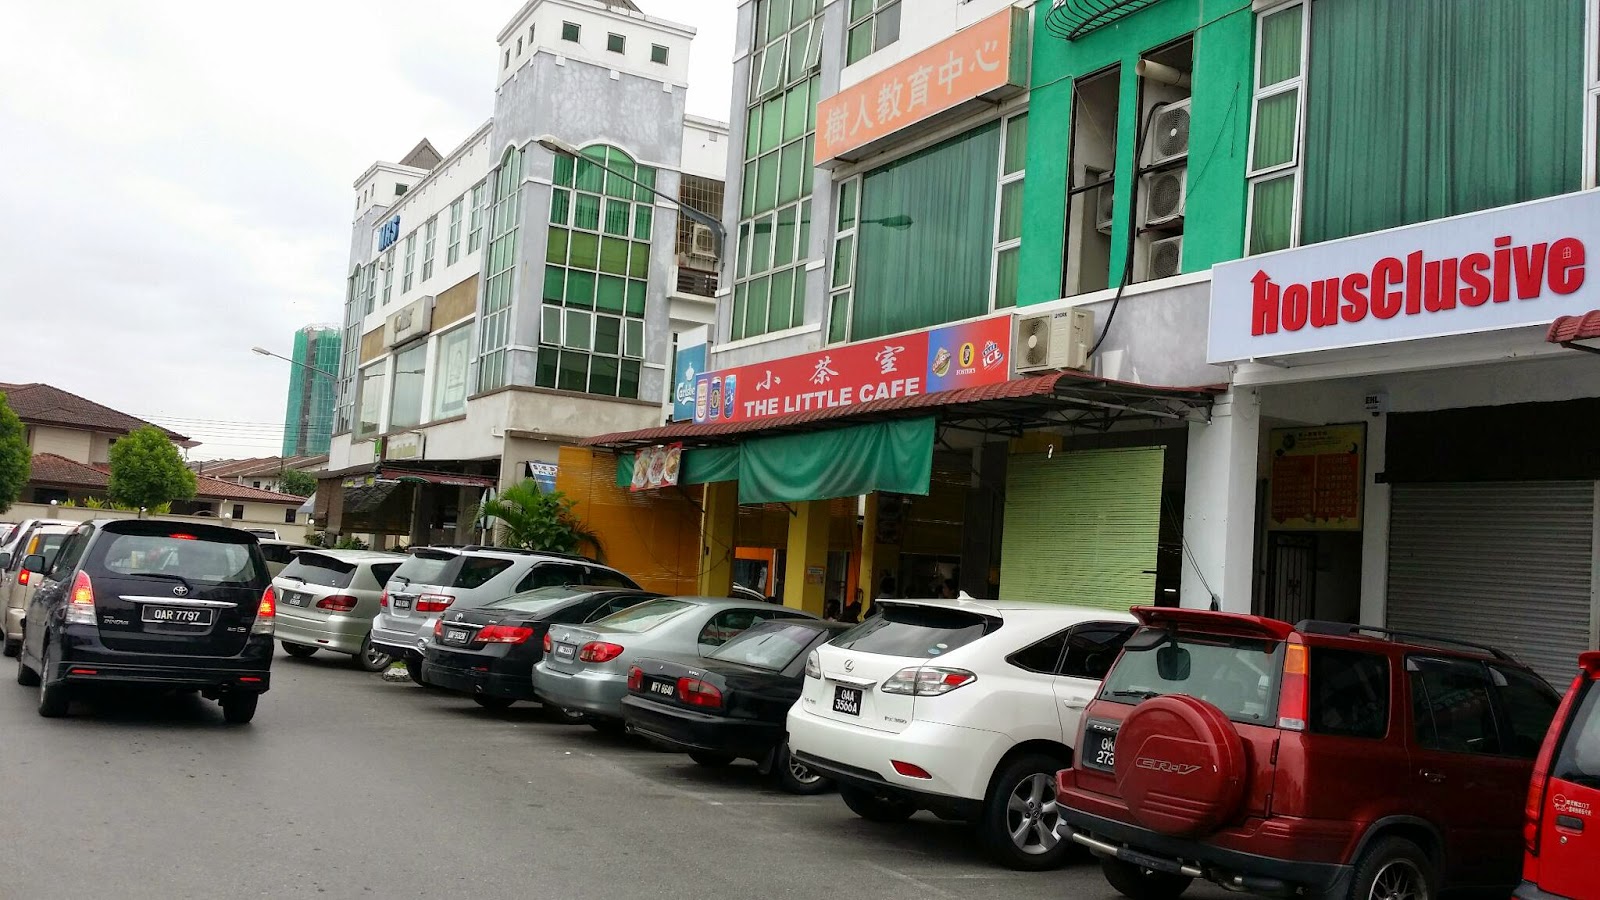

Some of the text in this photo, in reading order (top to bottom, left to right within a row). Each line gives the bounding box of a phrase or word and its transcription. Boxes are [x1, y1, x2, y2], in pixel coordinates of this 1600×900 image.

[823, 40, 1000, 148] 樹人教育中心
[982, 350, 1002, 367] ICE
[755, 345, 905, 392] 小茶室
[744, 377, 920, 418] THE LITTLE CAFE
[154, 609, 201, 621] QAR 7797
[841, 689, 855, 702] QAA
[835, 699, 858, 713] 3566A
[1101, 737, 1115, 752] QK
[1096, 750, 1115, 766] 273
[1136, 757, 1202, 776] CR-V
